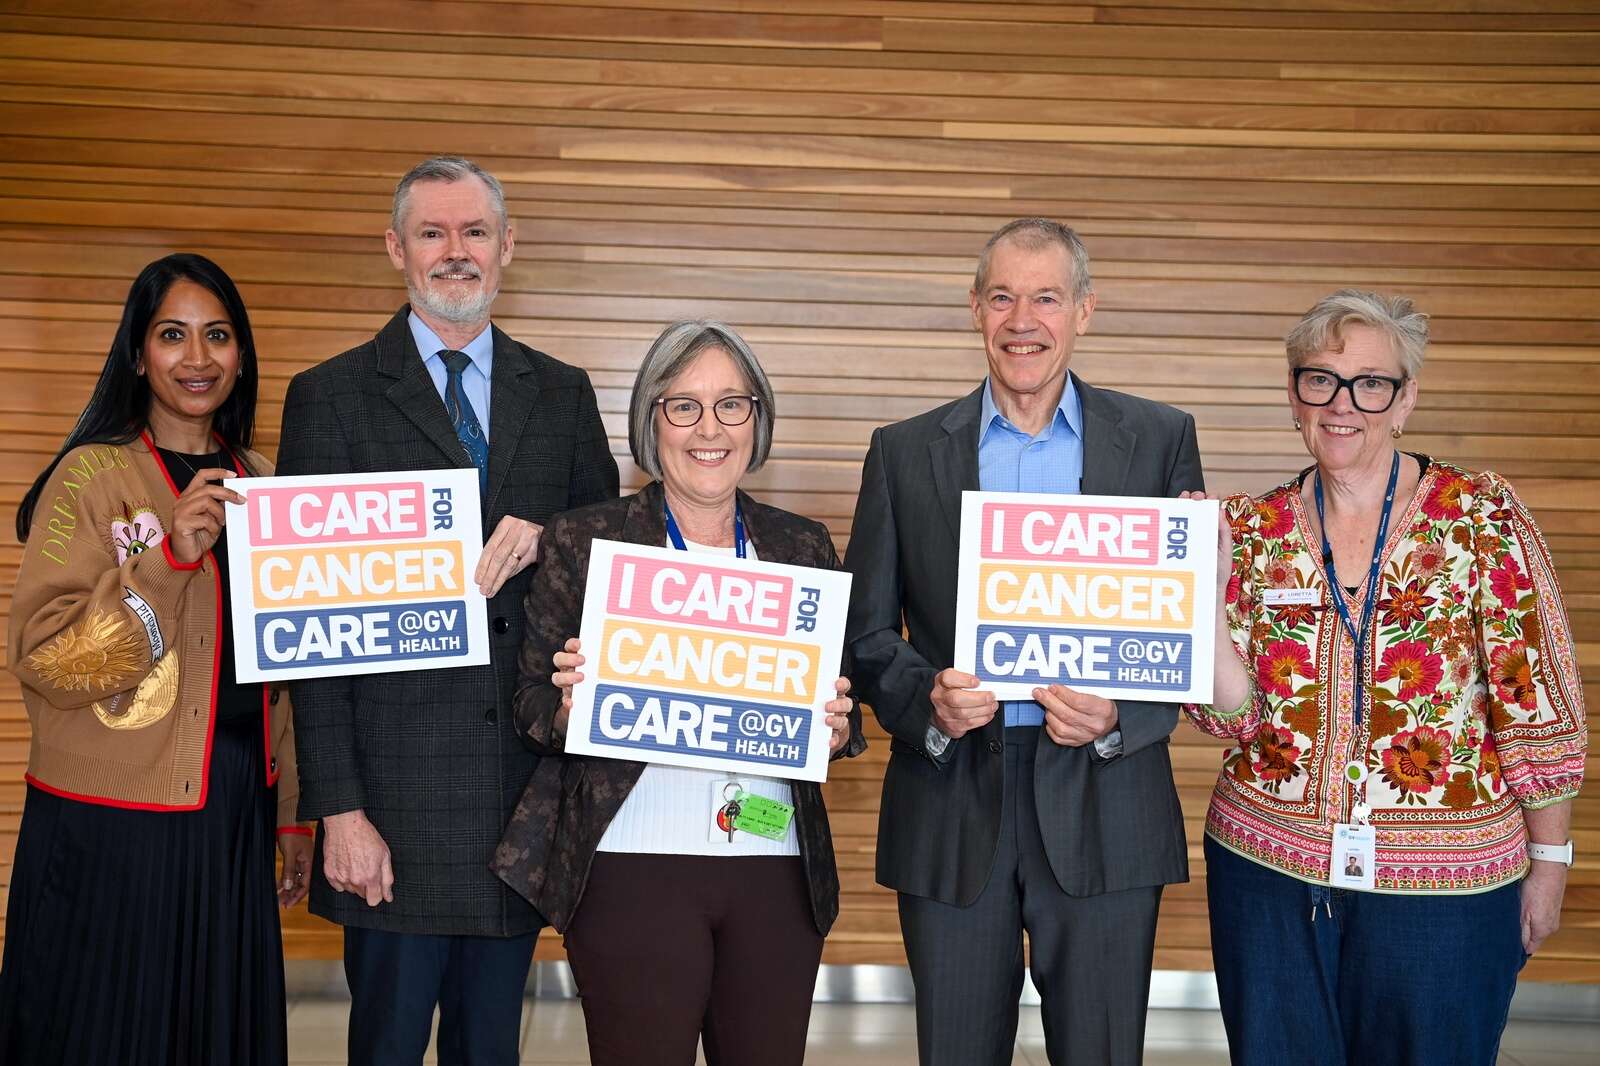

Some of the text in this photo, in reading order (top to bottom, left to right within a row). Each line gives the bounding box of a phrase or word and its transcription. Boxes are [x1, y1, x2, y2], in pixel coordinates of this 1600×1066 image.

[258, 488, 418, 539] I CARE
[432, 487, 453, 531] FOR
[991, 509, 1150, 558] I CARE
[1166, 516, 1188, 560] FOR
[259, 548, 458, 601] CANCER
[618, 562, 783, 629] I CARE
[985, 570, 1185, 622] CANCER
[397, 609, 458, 636] @GV
[795, 586, 821, 633] FOR
[262, 612, 392, 663] CARE
[399, 636, 460, 654] HEALTH
[982, 631, 1112, 681] CARE
[1118, 638, 1184, 664] @GV
[607, 627, 810, 697] CANCER
[1118, 667, 1183, 684] HEALTH
[599, 692, 732, 752] CARE
[738, 709, 803, 739] @GV
[735, 738, 800, 760] HEALTH
